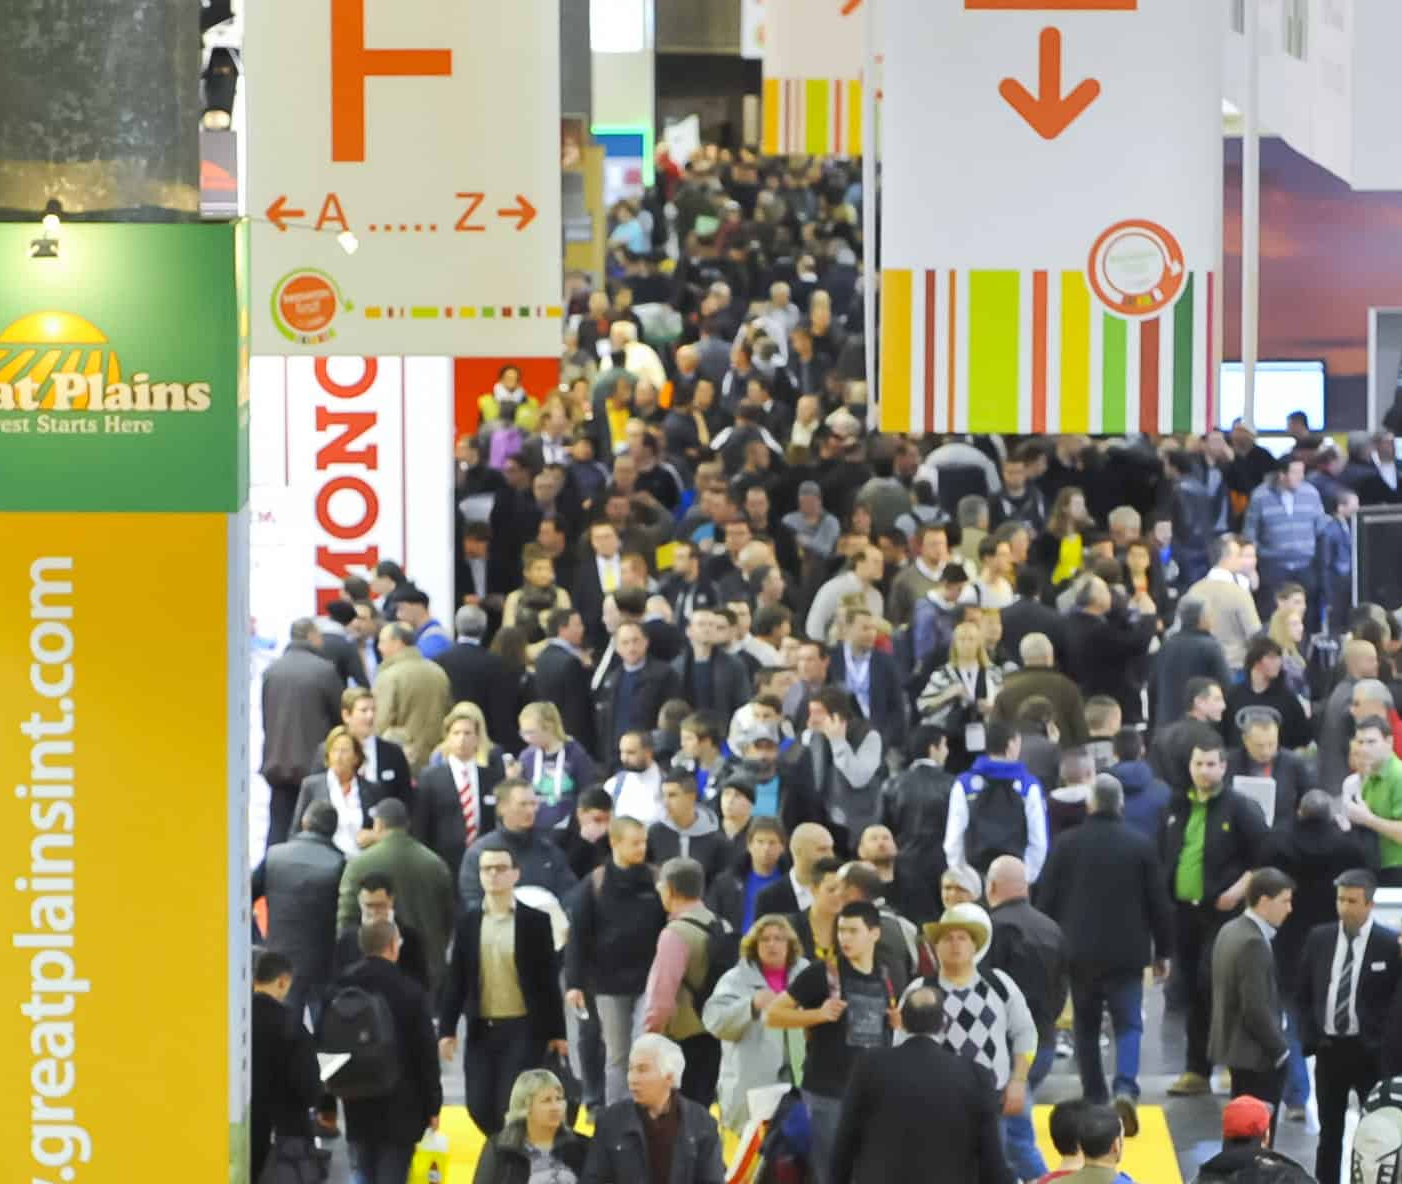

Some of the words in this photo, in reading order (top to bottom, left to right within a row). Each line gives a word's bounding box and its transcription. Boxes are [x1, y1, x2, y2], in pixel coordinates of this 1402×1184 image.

[315, 192, 351, 231] A
[454, 192, 486, 231] Z
[50, 372, 212, 412] Plains
[36, 414, 97, 433] Starts
[104, 415, 154, 433] Here
